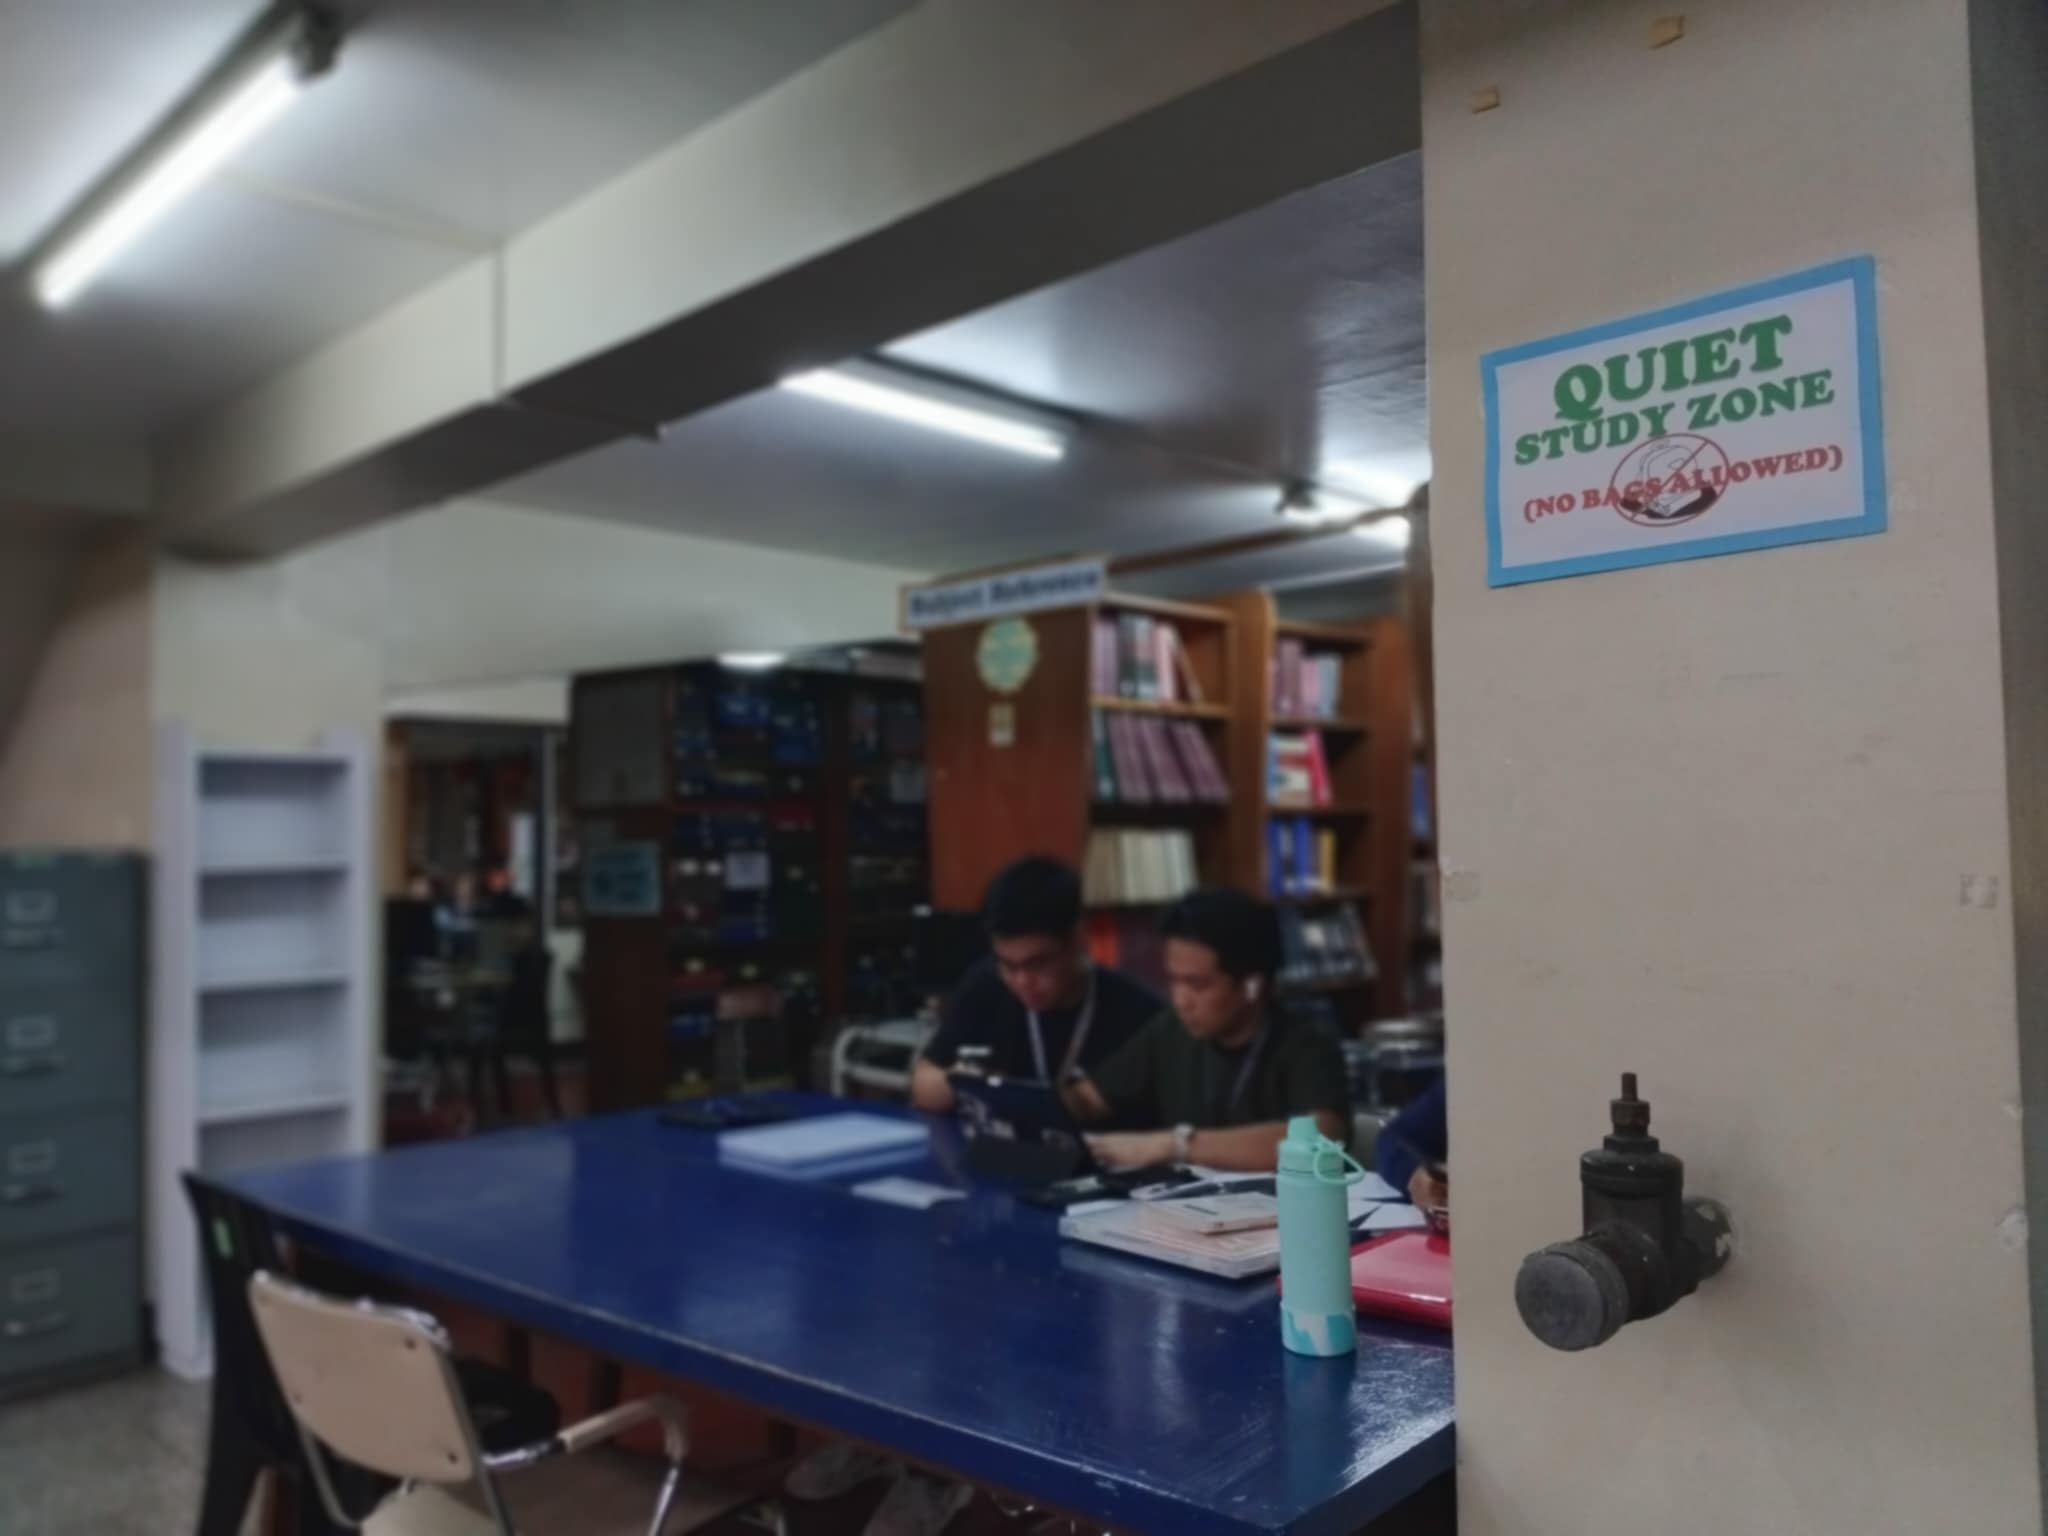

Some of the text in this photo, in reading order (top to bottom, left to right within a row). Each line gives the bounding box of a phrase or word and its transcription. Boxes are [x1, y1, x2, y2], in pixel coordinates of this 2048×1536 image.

[1553, 314, 1792, 421] QUIET
[1514, 369, 1835, 465] STUDY ZONE
[1524, 445, 1843, 523] (NO BAGS ALLOWED)
